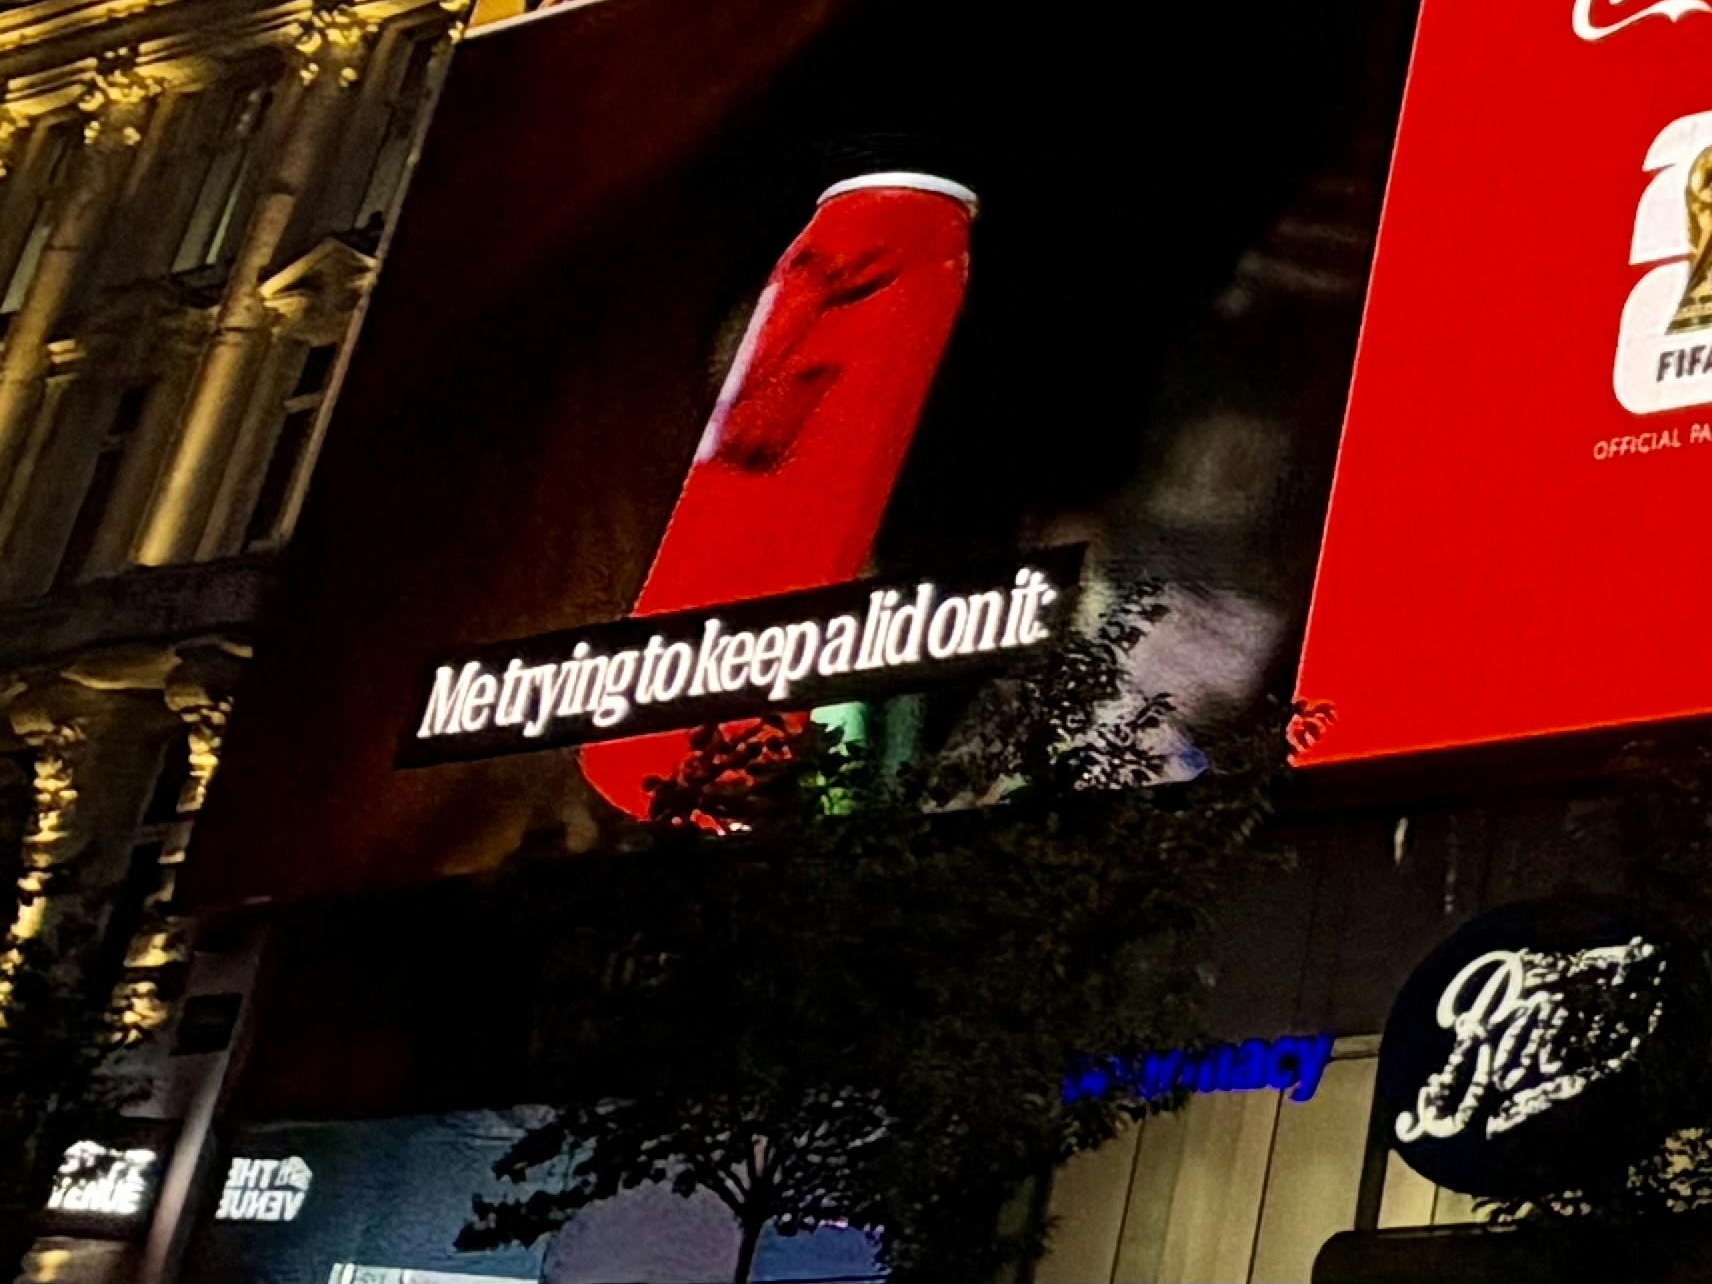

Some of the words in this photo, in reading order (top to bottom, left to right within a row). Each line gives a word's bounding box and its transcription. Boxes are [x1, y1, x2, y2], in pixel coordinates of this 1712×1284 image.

[1593, 428, 1682, 461] OFFICIAL
[416, 661, 497, 739] Me
[495, 642, 640, 738] trying
[635, 634, 693, 705] to
[687, 618, 820, 702] keep
[817, 614, 859, 677] a
[855, 582, 935, 670] lid
[928, 590, 1003, 659] on
